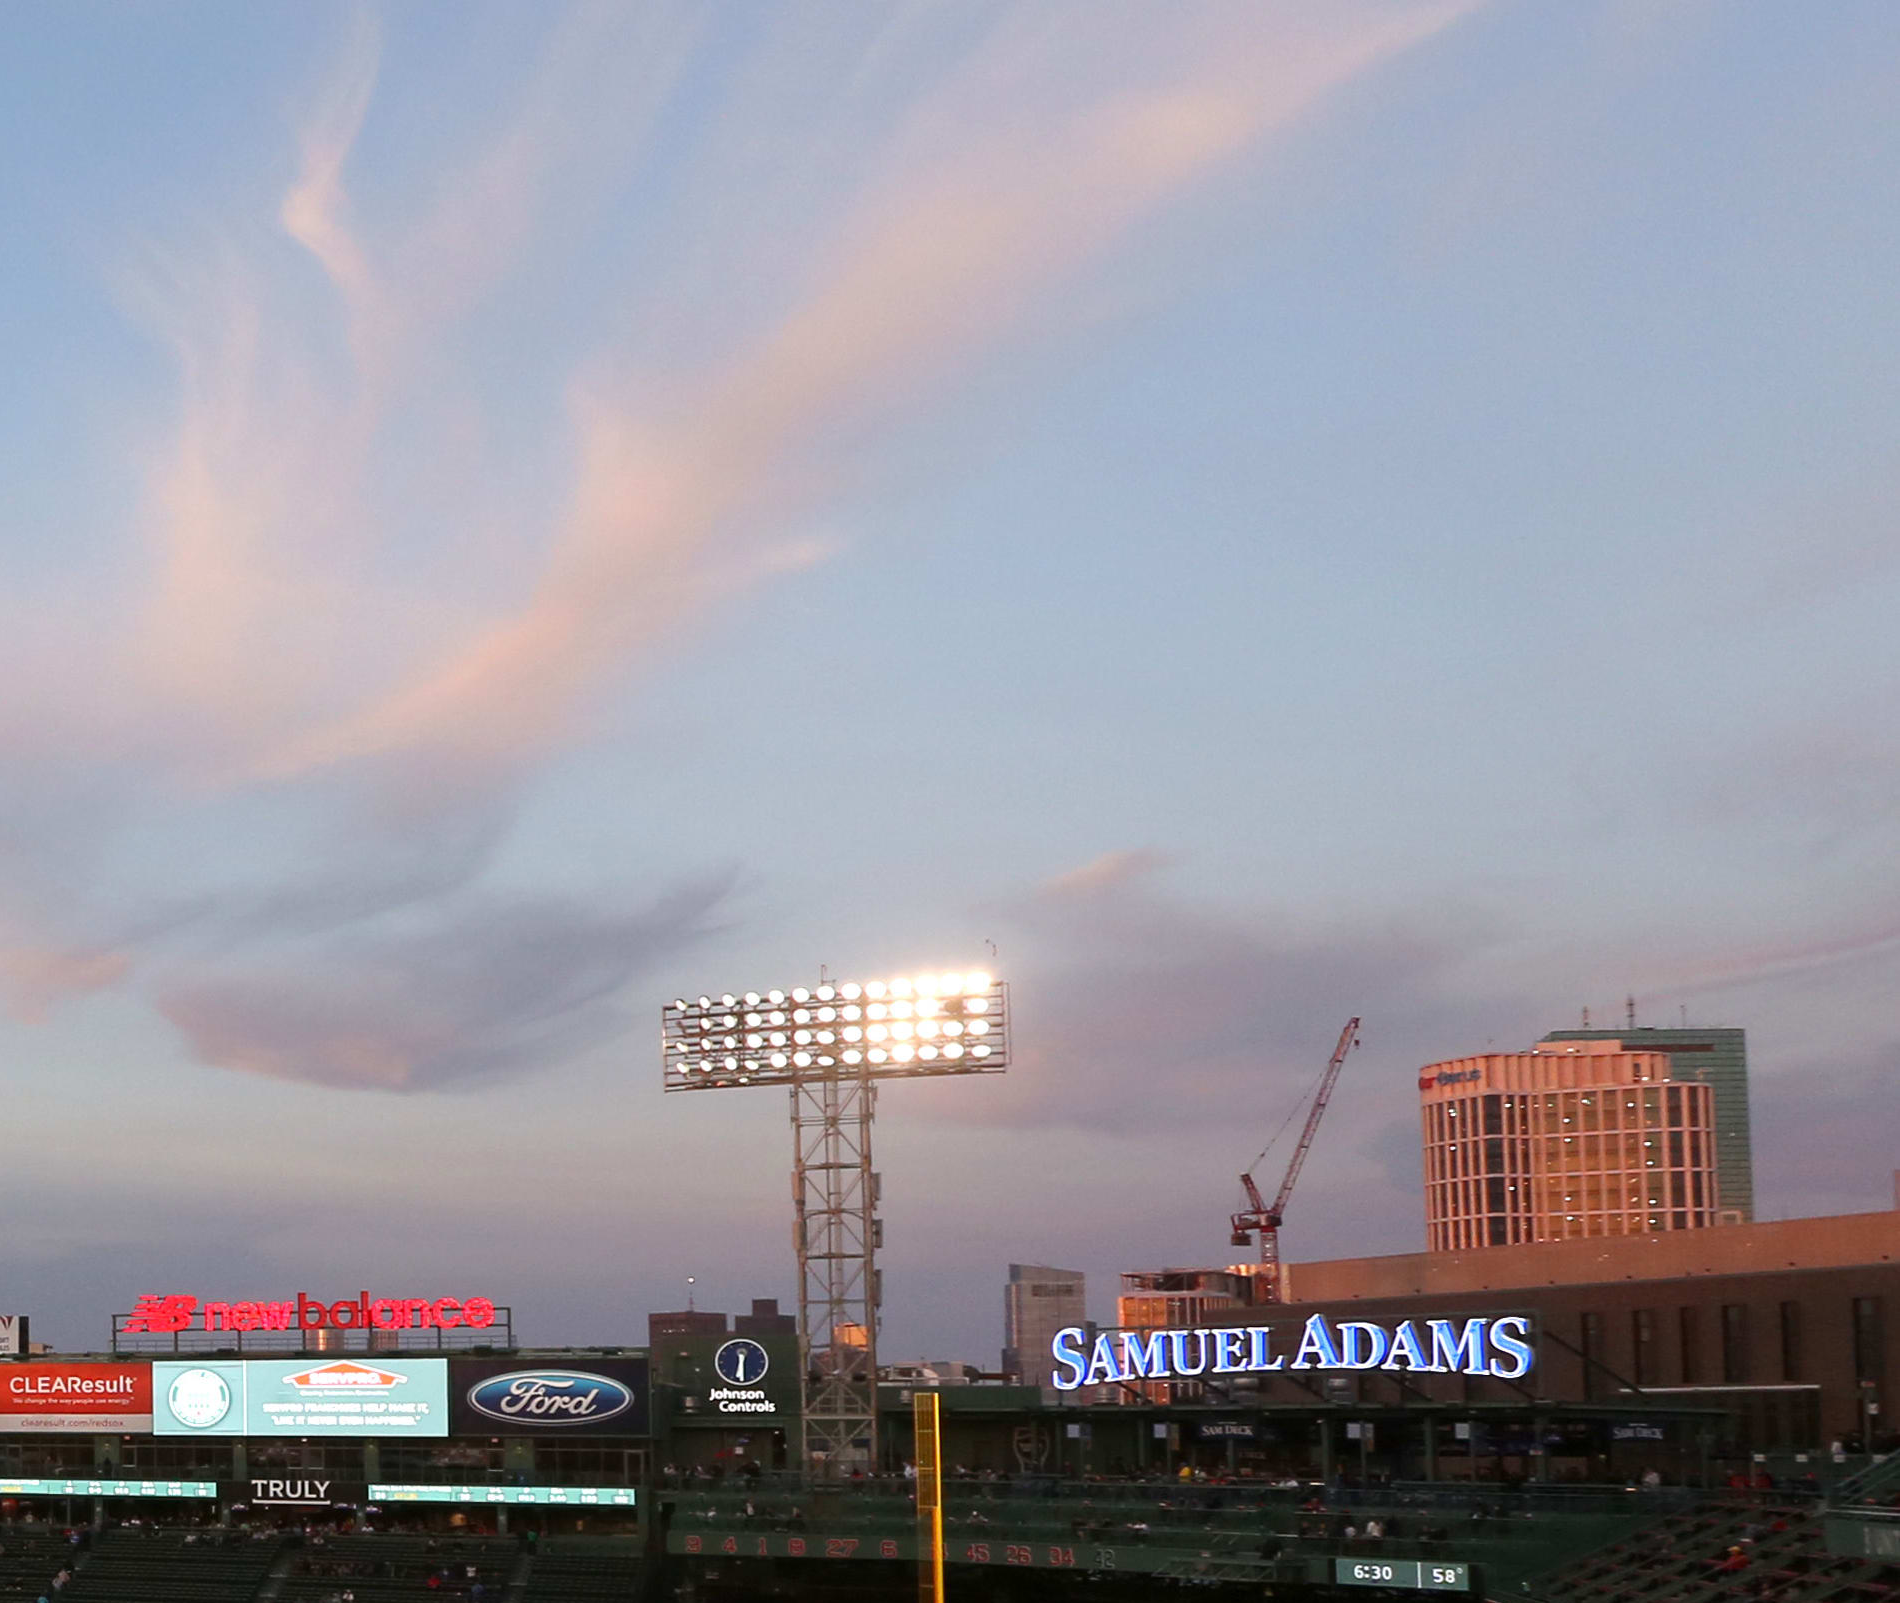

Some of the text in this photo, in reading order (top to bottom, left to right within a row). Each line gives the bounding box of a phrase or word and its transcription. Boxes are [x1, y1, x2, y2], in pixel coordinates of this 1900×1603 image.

[203, 1290, 495, 1331] new balance
[1051, 1313, 1533, 1390] SAMUEL ADAMS
[10, 1375, 134, 1394] CLEAResult
[709, 1387, 766, 1401] Johnson
[500, 1378, 601, 1415] Ford
[718, 1400, 776, 1413] Controls
[252, 1479, 330, 1498] TRULY
[1353, 1565, 1393, 1581] 6:30
